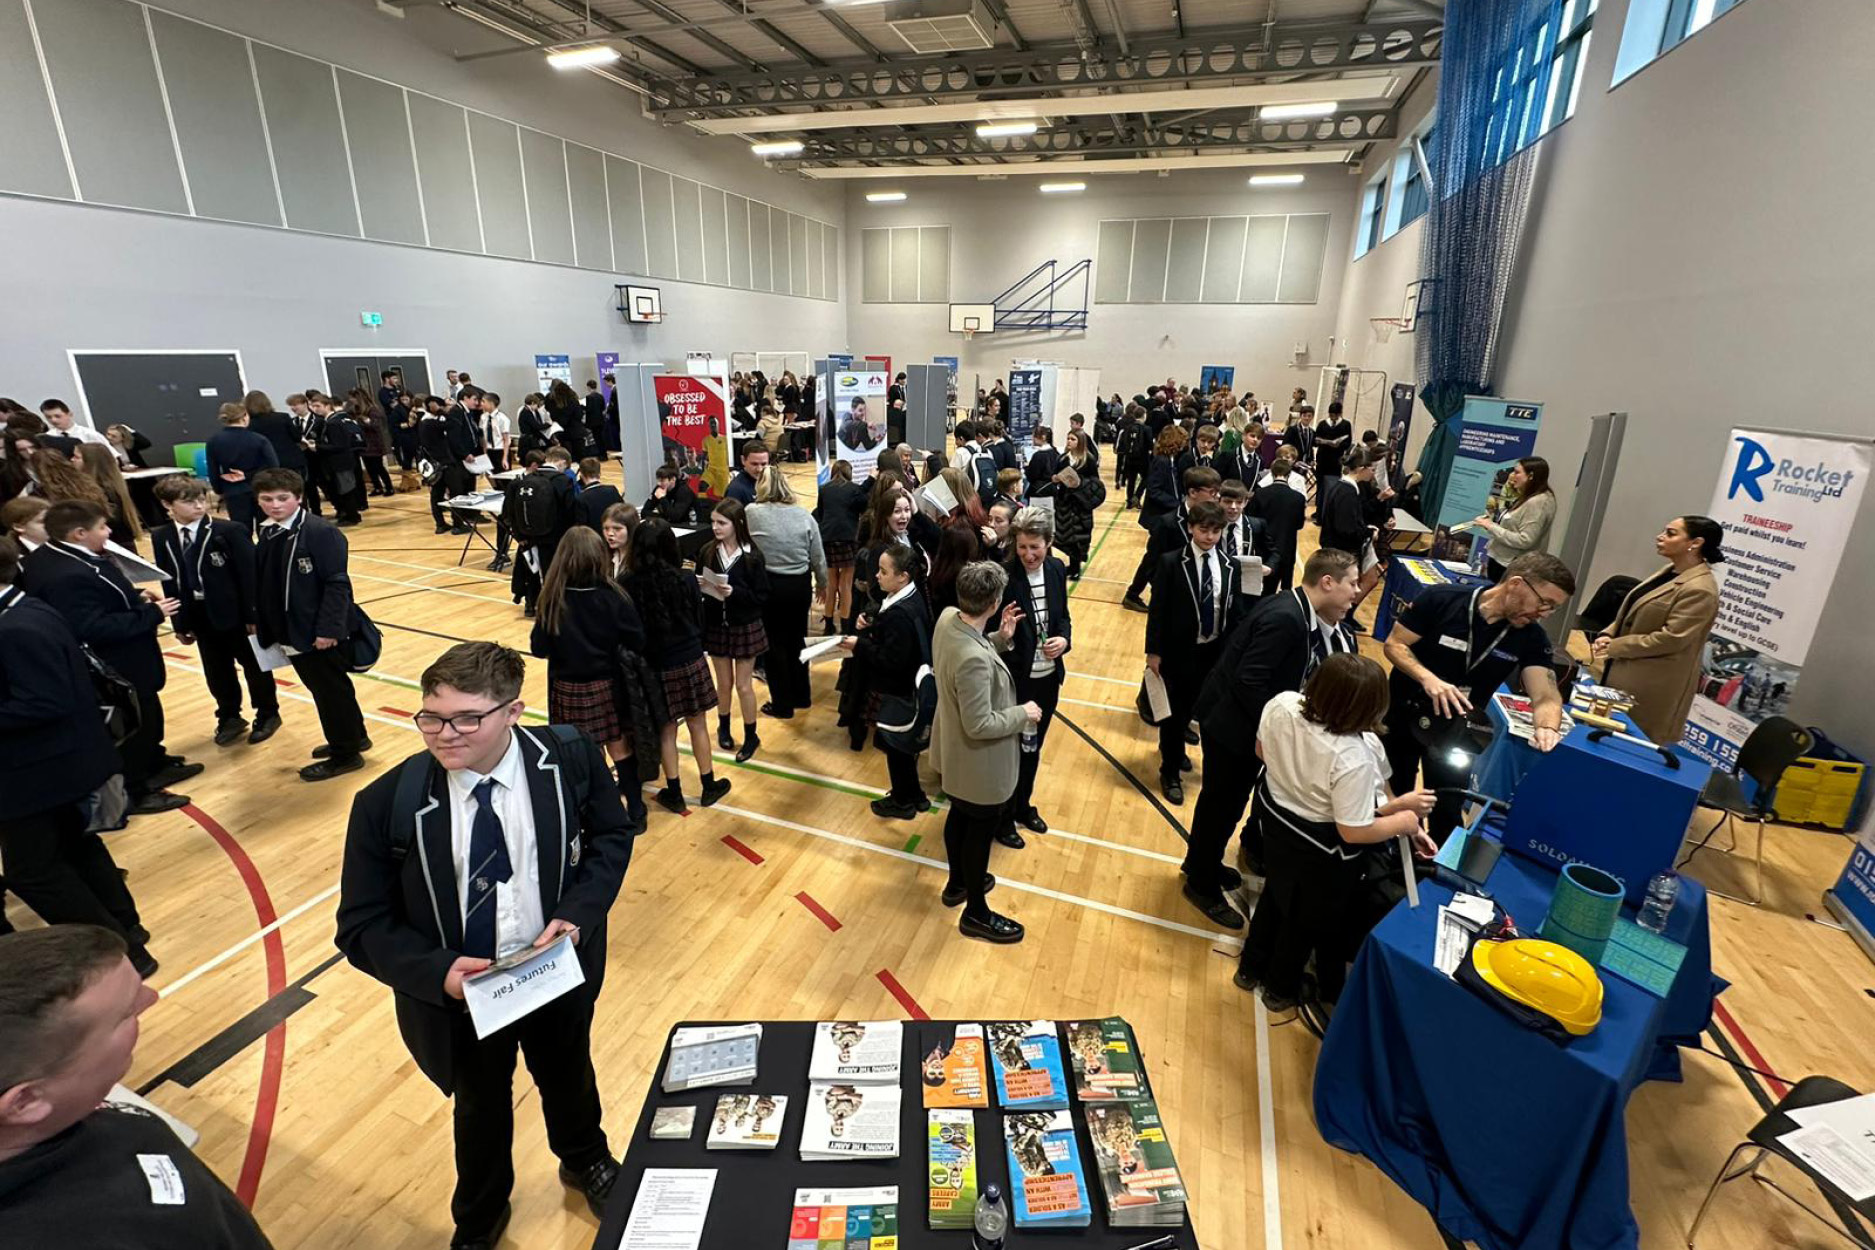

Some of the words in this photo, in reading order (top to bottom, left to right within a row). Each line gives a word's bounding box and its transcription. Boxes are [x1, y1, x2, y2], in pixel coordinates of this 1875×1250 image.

[664, 392, 706, 404] OBSESSED
[673, 404, 685, 414] TO
[687, 404, 697, 414] BE
[1509, 406, 1534, 418] TTE
[666, 416, 682, 426] THE
[684, 414, 706, 426] BEST
[1778, 459, 1854, 487] Rocket
[1772, 479, 1823, 502] Training
[1822, 486, 1842, 498] Ltd
[1721, 521, 1732, 531] Get
[1733, 525, 1748, 535] paid
[1750, 528, 1771, 540] whilst
[1772, 534, 1786, 543] you
[1743, 514, 1794, 532] TRAINEESHIP
[1720, 545, 1745, 556] usiness
[1746, 550, 1796, 571] Administration
[1727, 568, 1771, 590] Warehousing
[1755, 564, 1781, 579] Service
[1724, 579, 1766, 598] Construction
[1720, 588, 1744, 604] Vehicle
[1744, 597, 1784, 619] Engineering
[1732, 604, 1755, 620] Social
[1756, 612, 1772, 624] Care
[1734, 618, 1760, 632] English
[1738, 628, 1748, 639] up
[1748, 632, 1756, 641] to
[1712, 740, 1740, 762] 155
[515, 960, 556, 988] Futures
[492, 982, 514, 1000] Fair
[828, 1141, 852, 1150] ARMY
[852, 1142, 864, 1151] THE
[865, 1142, 894, 1152] JOINING
[931, 1189, 958, 1197] CAREERS
